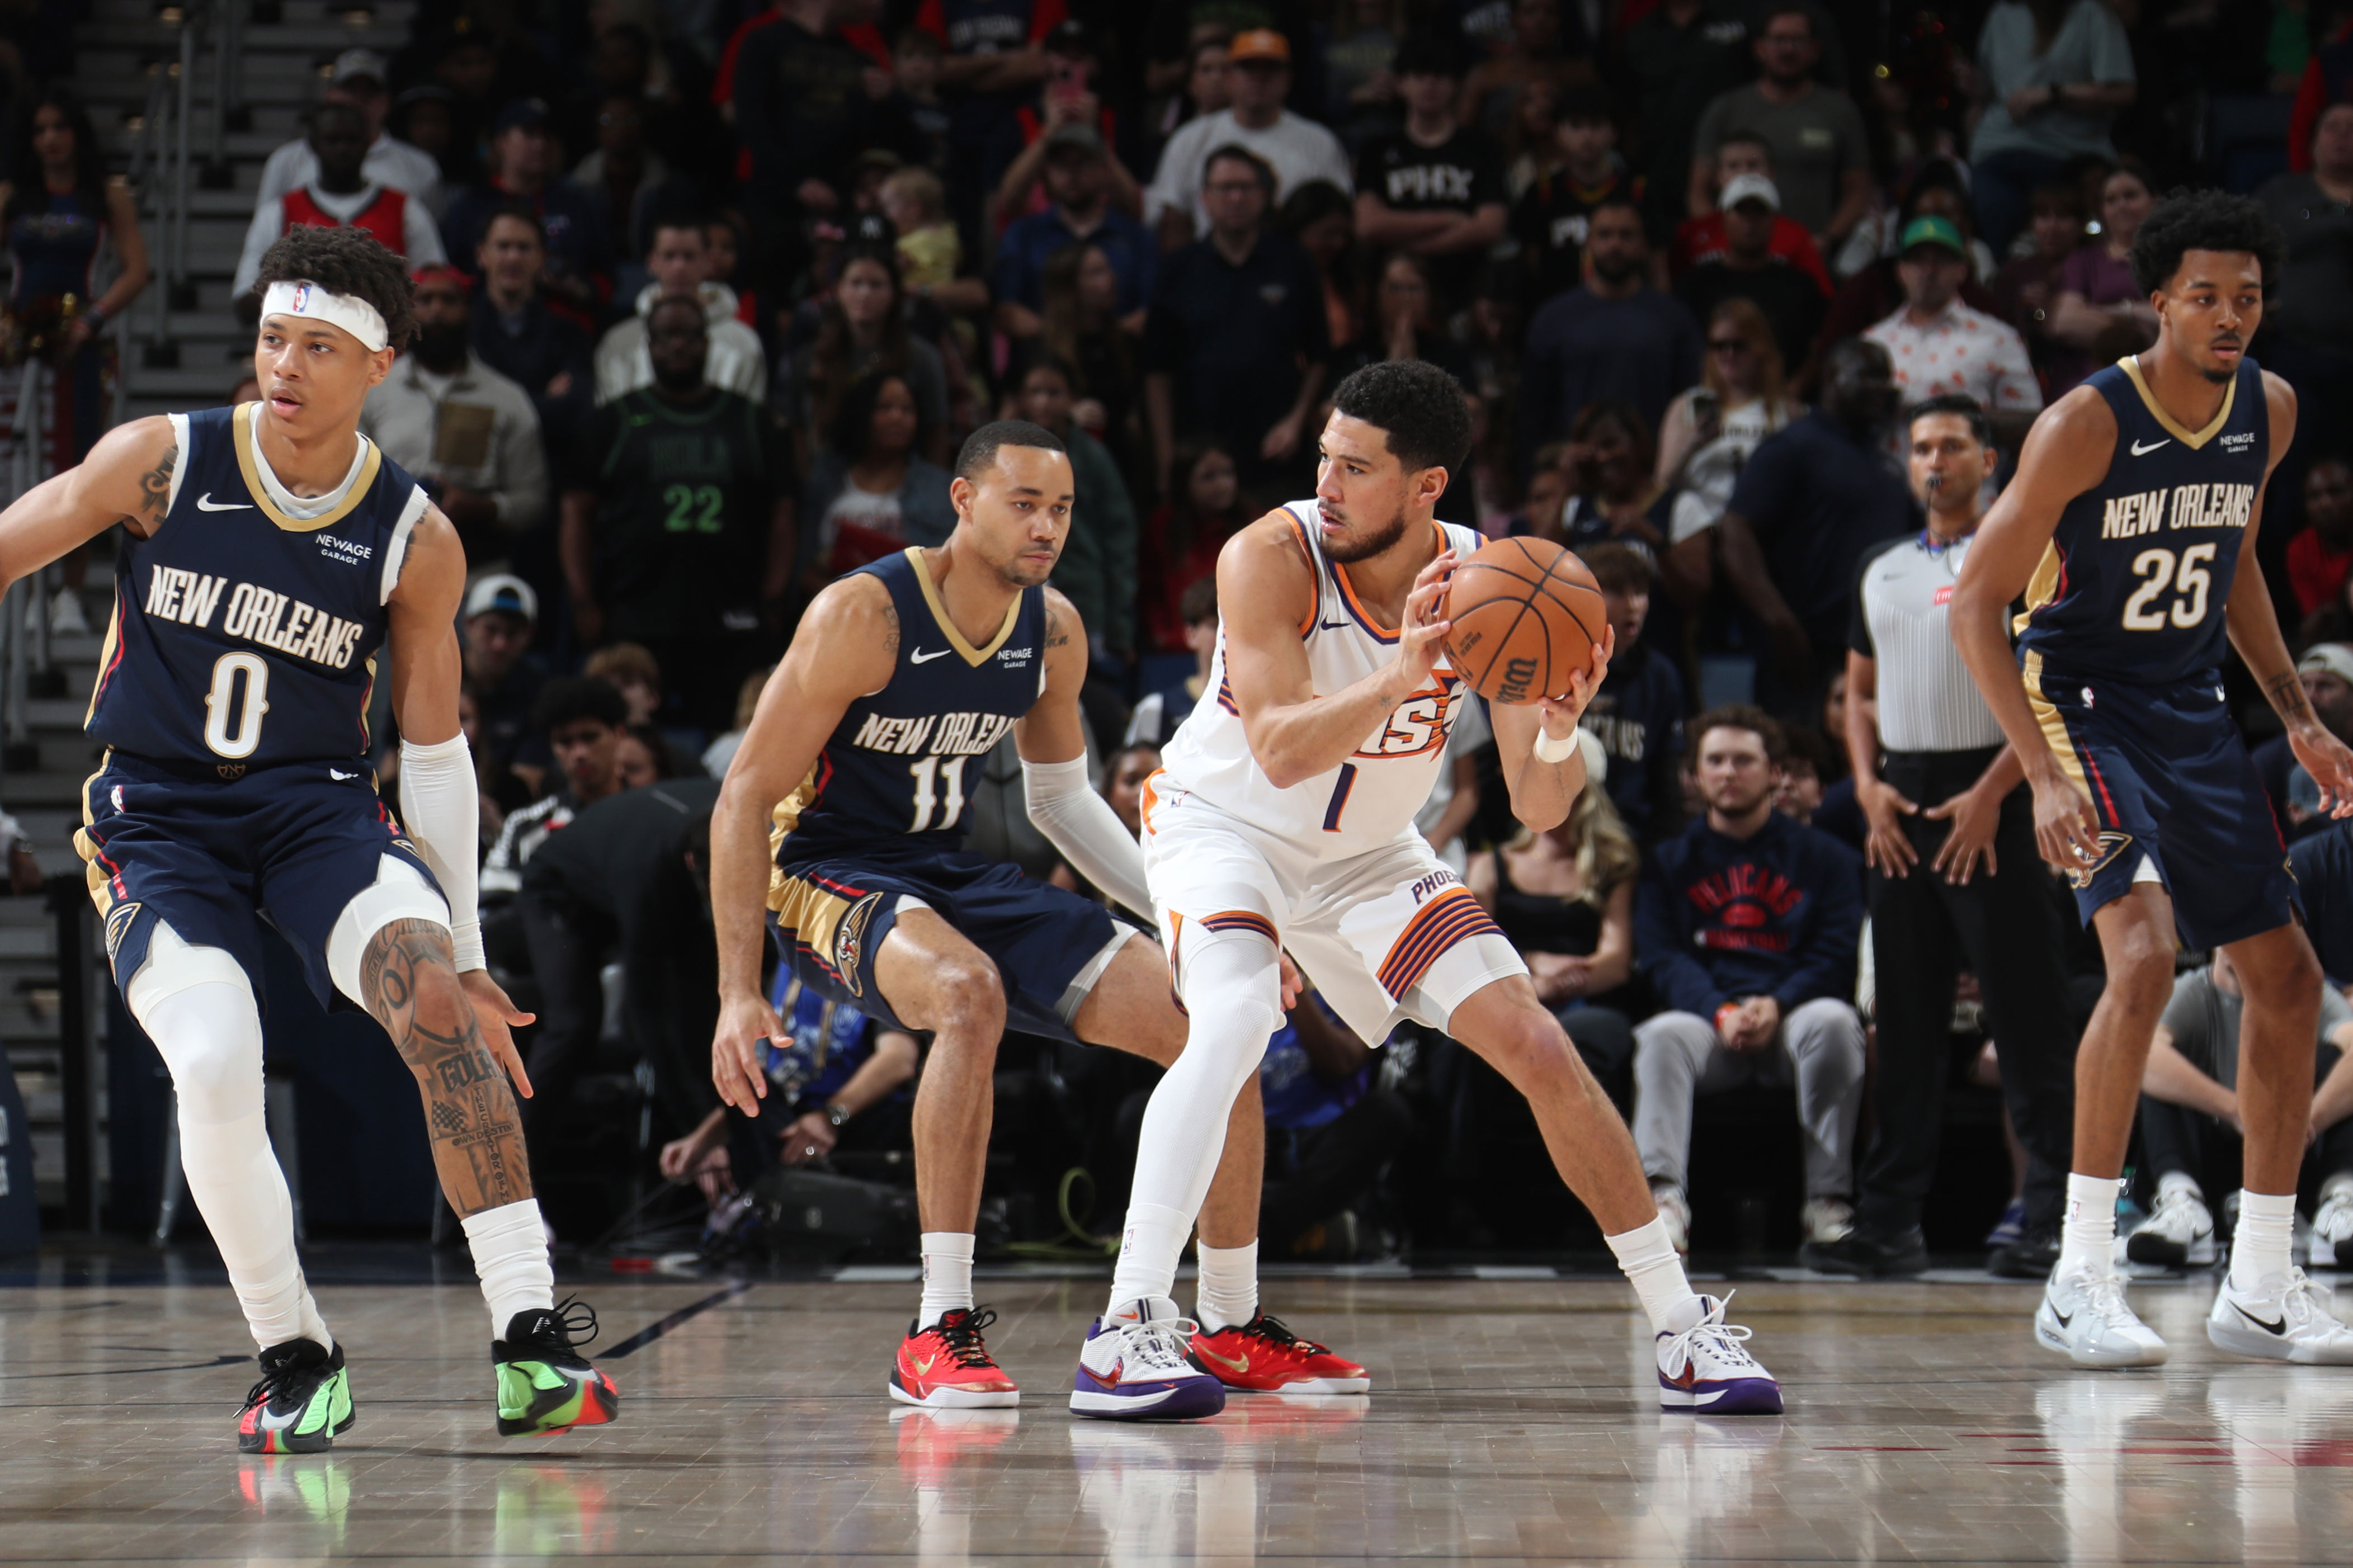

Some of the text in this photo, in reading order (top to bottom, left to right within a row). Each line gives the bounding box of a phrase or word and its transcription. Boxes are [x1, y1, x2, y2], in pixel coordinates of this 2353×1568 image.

[1385, 164, 1474, 203] PHX
[2220, 433, 2255, 446] NEWAGE
[663, 483, 724, 534] 22
[2101, 483, 2254, 539] NEW ORLEANS
[315, 533, 372, 559] NEWAGE
[321, 549, 359, 565] GARAGE
[2122, 542, 2217, 631] 25
[145, 564, 364, 669] NEW ORLEANS
[998, 648, 1032, 660] NEWAGE
[1004, 660, 1026, 669] GARAGE
[204, 651, 270, 759] 0
[852, 712, 937, 755] NEW
[904, 755, 969, 834] 11
[1322, 762, 1359, 833] 1
[1411, 870, 1462, 905] PHOE
